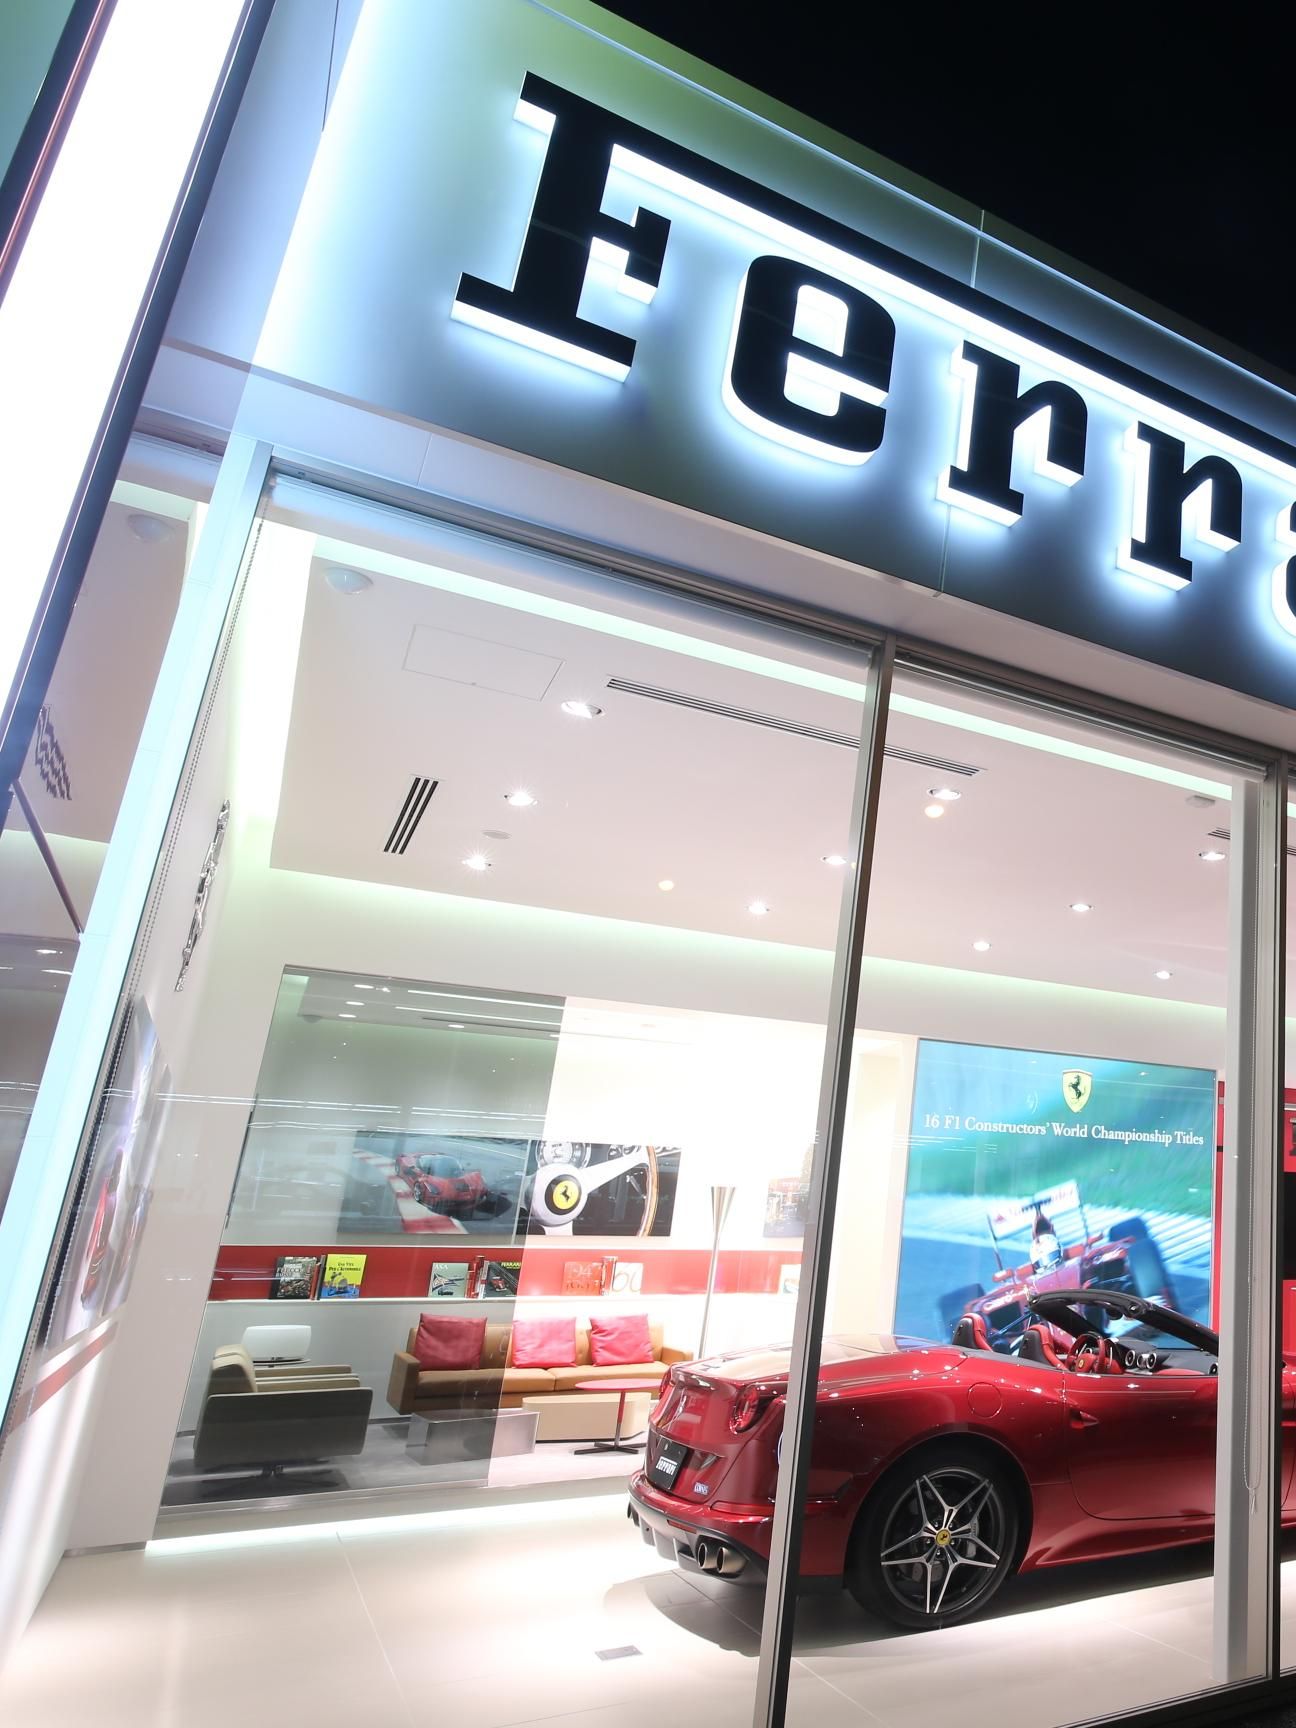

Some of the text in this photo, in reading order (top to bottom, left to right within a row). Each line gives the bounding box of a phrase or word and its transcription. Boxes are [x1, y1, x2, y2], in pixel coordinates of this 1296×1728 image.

[924, 1114, 1204, 1147] 16 F1 Constructors' World Championship Titles
